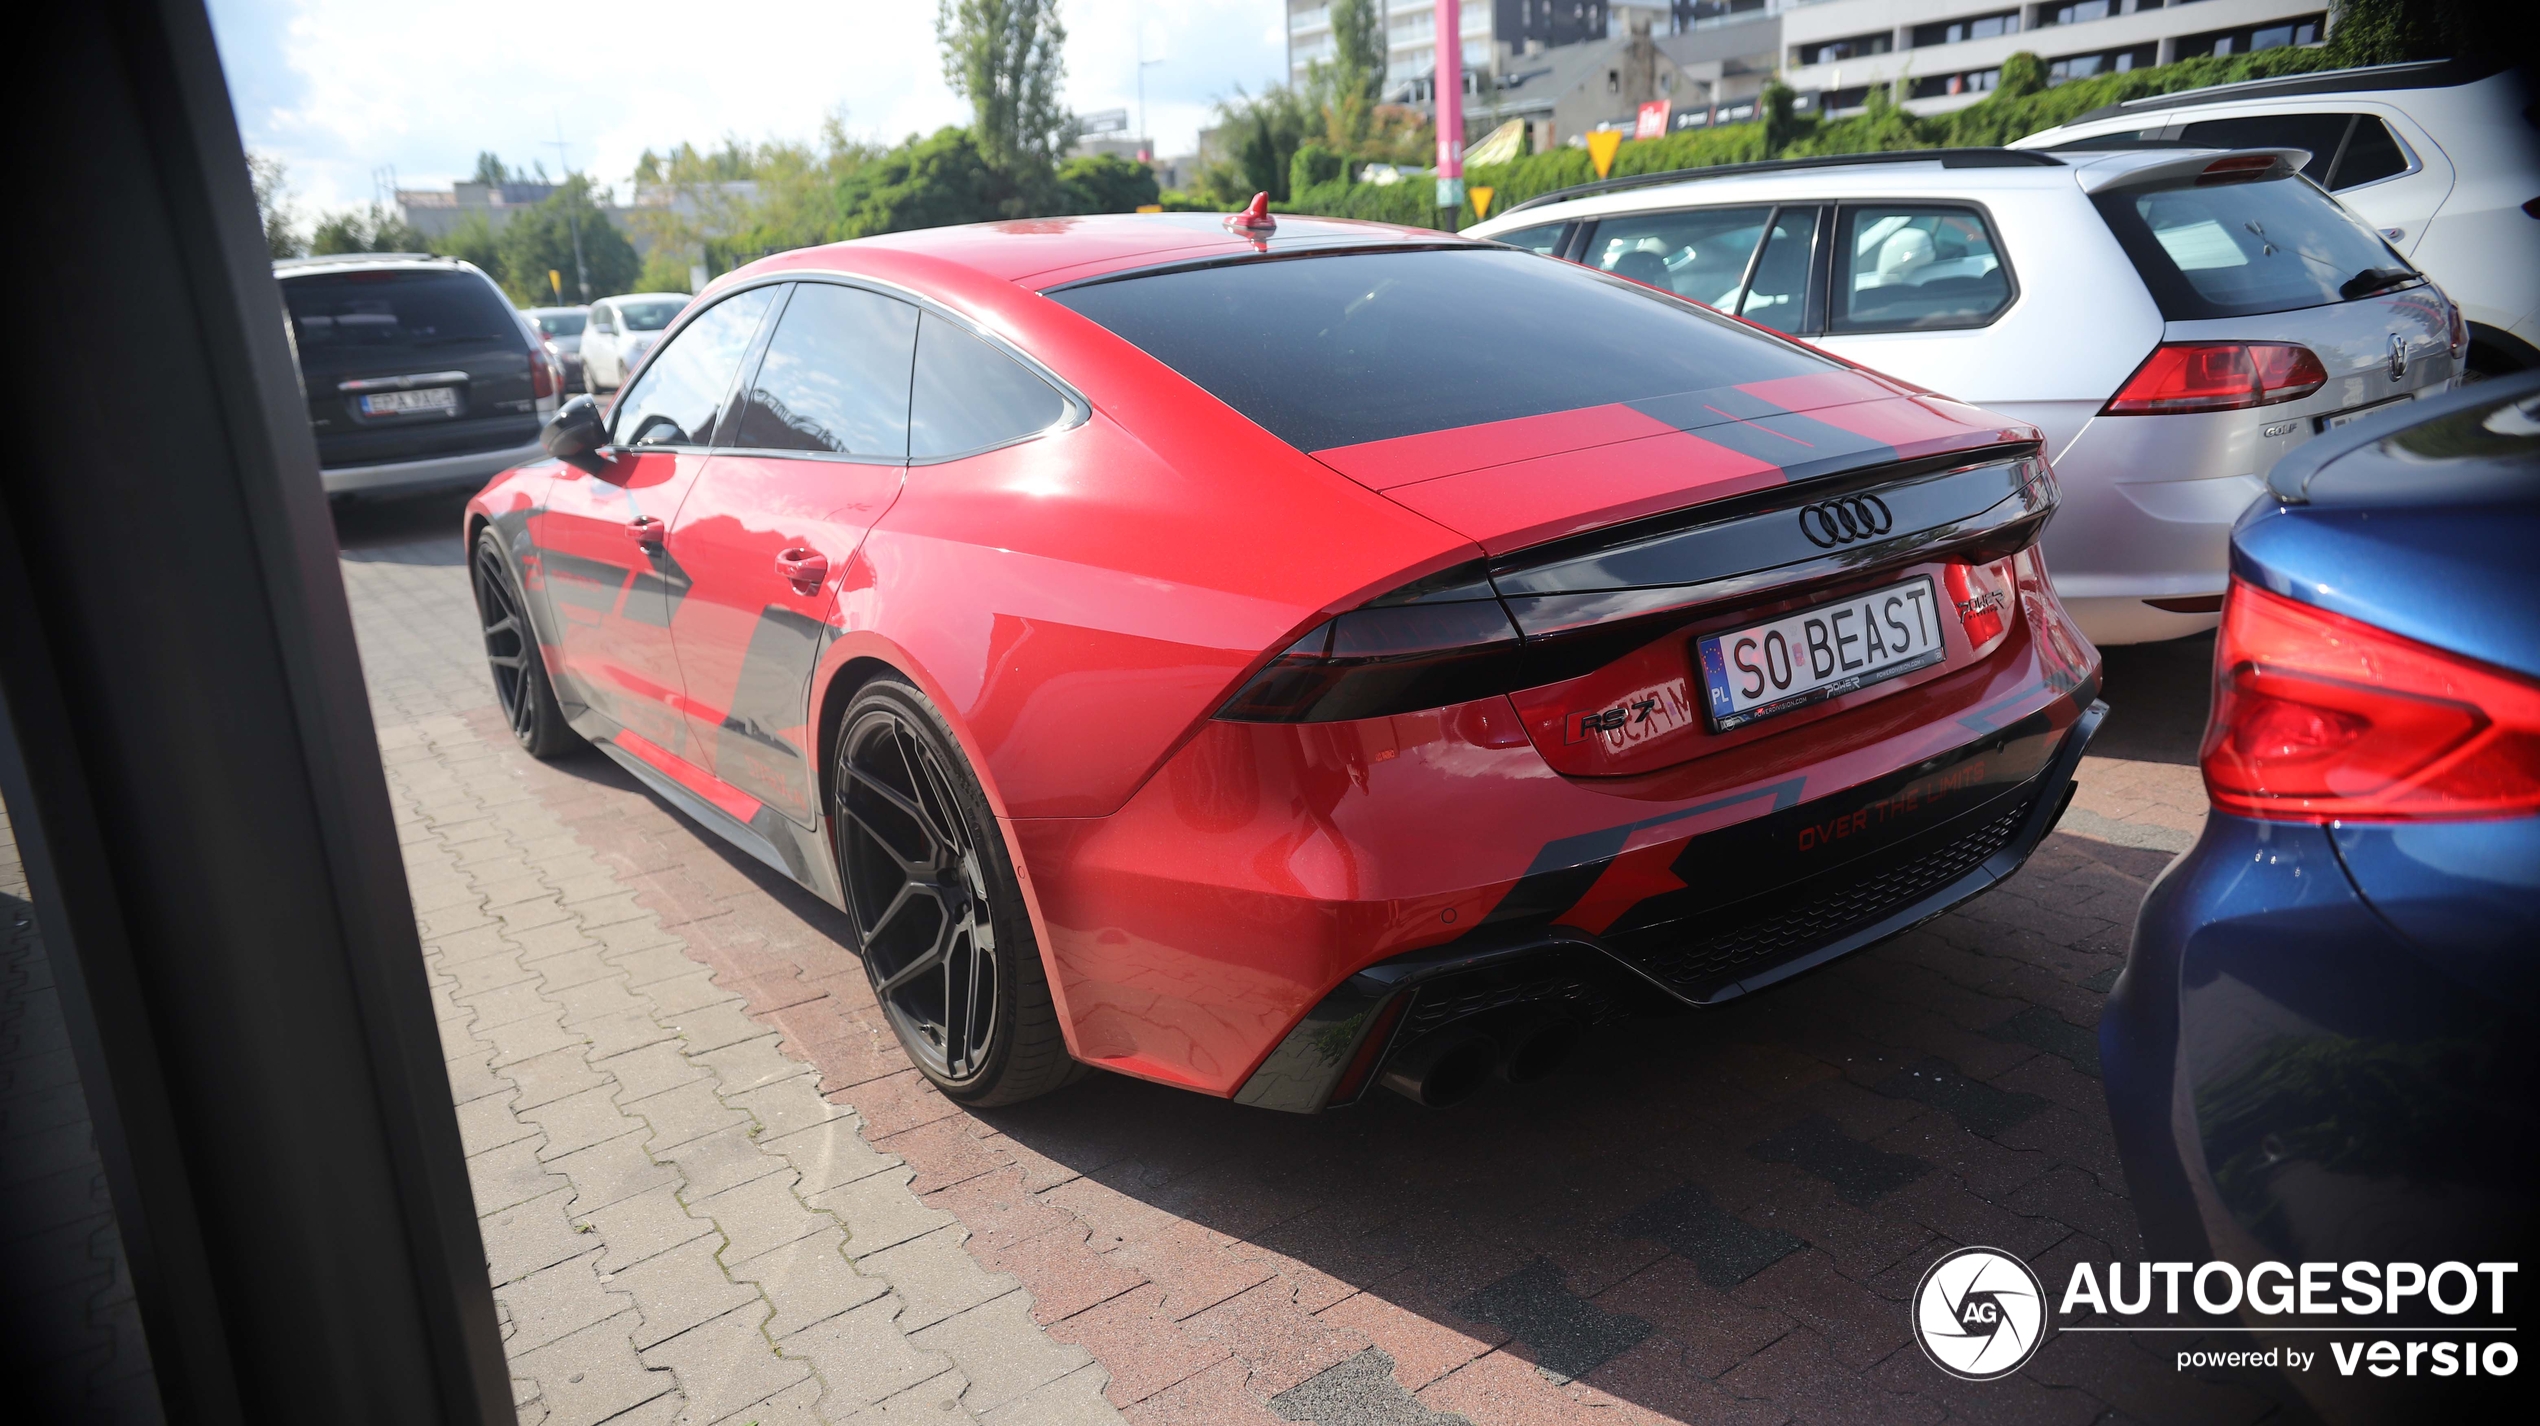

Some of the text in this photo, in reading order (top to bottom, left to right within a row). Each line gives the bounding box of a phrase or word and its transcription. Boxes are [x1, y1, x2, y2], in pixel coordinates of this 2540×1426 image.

[2264, 423, 2298, 438] GOLF
[1804, 588, 1927, 680] BEAST
[1711, 686, 1729, 706] PL
[1824, 675, 1860, 699] POWER
[1754, 696, 1807, 718] POWERDIVISION.COM
[1798, 761, 1986, 851] OVER THE LIMITS
